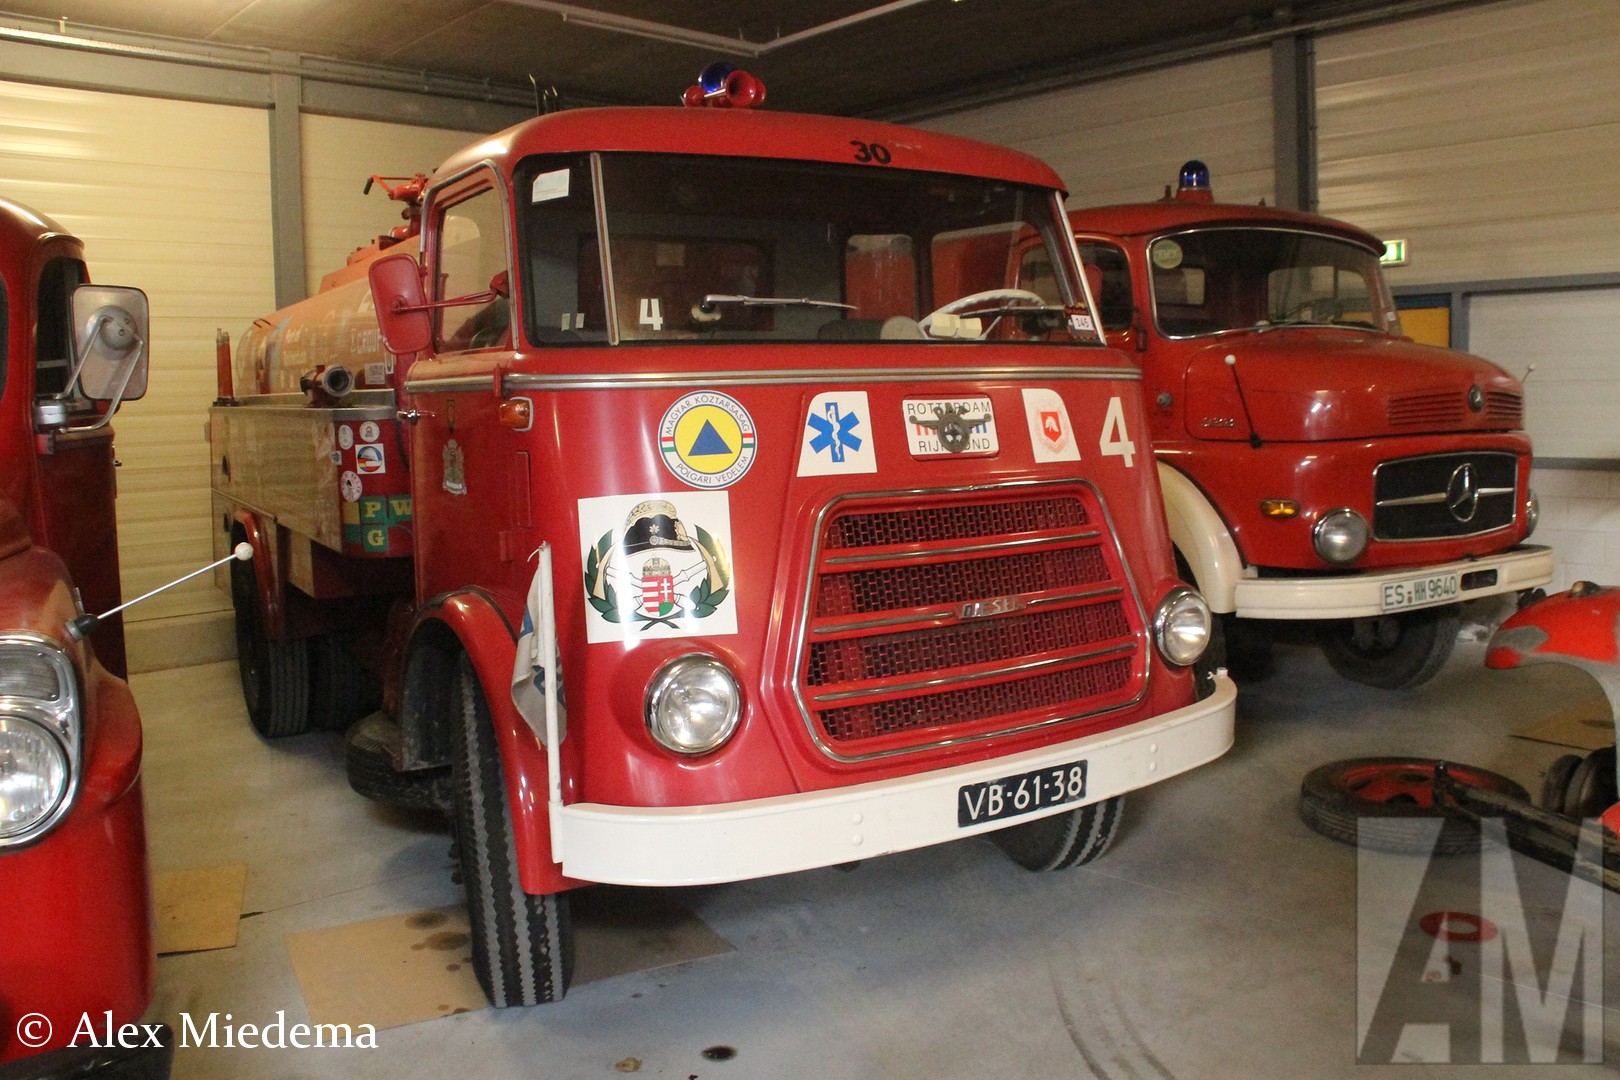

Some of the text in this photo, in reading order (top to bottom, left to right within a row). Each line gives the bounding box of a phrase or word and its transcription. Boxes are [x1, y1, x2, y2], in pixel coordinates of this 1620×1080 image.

[850, 140, 891, 164] 30
[639, 298, 663, 331] 4
[666, 400, 692, 435] MAGYAR
[907, 401, 991, 415] ROTTRDAM
[1099, 396, 1136, 468] 4
[364, 498, 412, 518] P W
[367, 529, 385, 546] G
[964, 766, 1083, 820] VB-61-38
